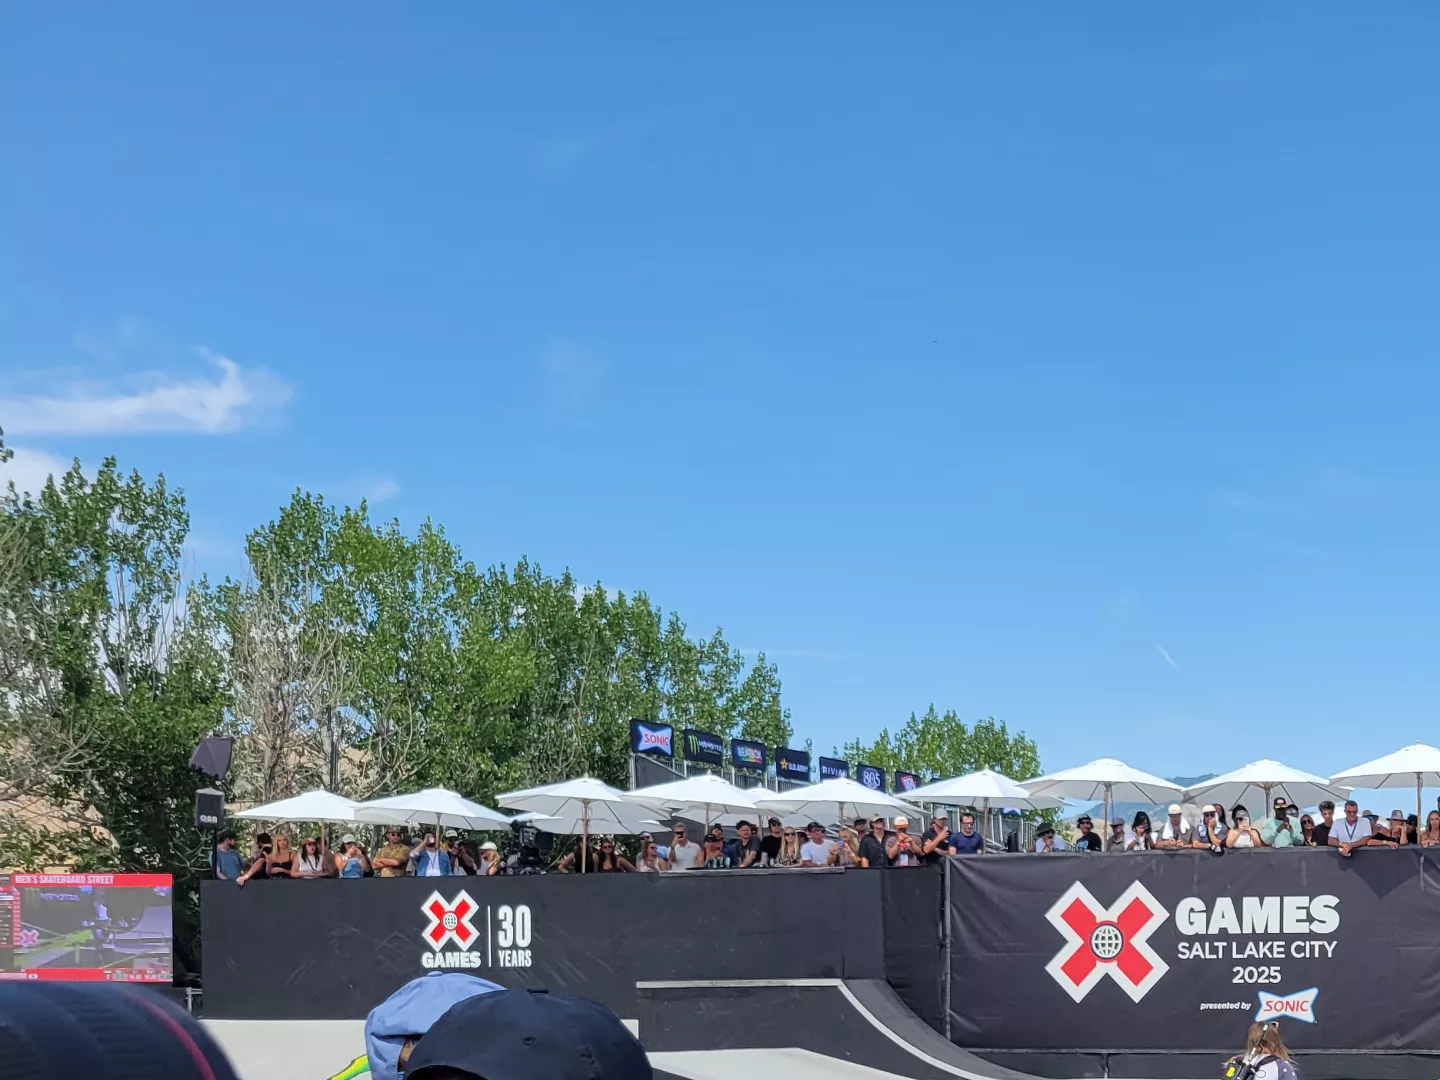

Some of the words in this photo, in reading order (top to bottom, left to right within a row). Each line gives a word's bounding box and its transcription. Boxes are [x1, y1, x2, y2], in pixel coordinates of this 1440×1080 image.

[643, 733, 669, 746] SONIC
[862, 771, 881, 788] 805
[15, 875, 38, 884] MEN'S
[39, 875, 86, 884] SKATEBOARD
[87, 875, 114, 884] STREET
[1174, 894, 1341, 936] GAMES
[498, 904, 532, 948] 30
[421, 950, 482, 969] GAMES
[498, 949, 533, 968] YEARS
[1177, 942, 1228, 960] SALT
[1231, 941, 1286, 959] LAKE
[1290, 940, 1338, 958] CITY
[1231, 965, 1282, 984] 2025
[1200, 1002, 1240, 1011] presented
[1240, 1002, 1252, 1011] by
[1263, 999, 1310, 1013] SONIC
